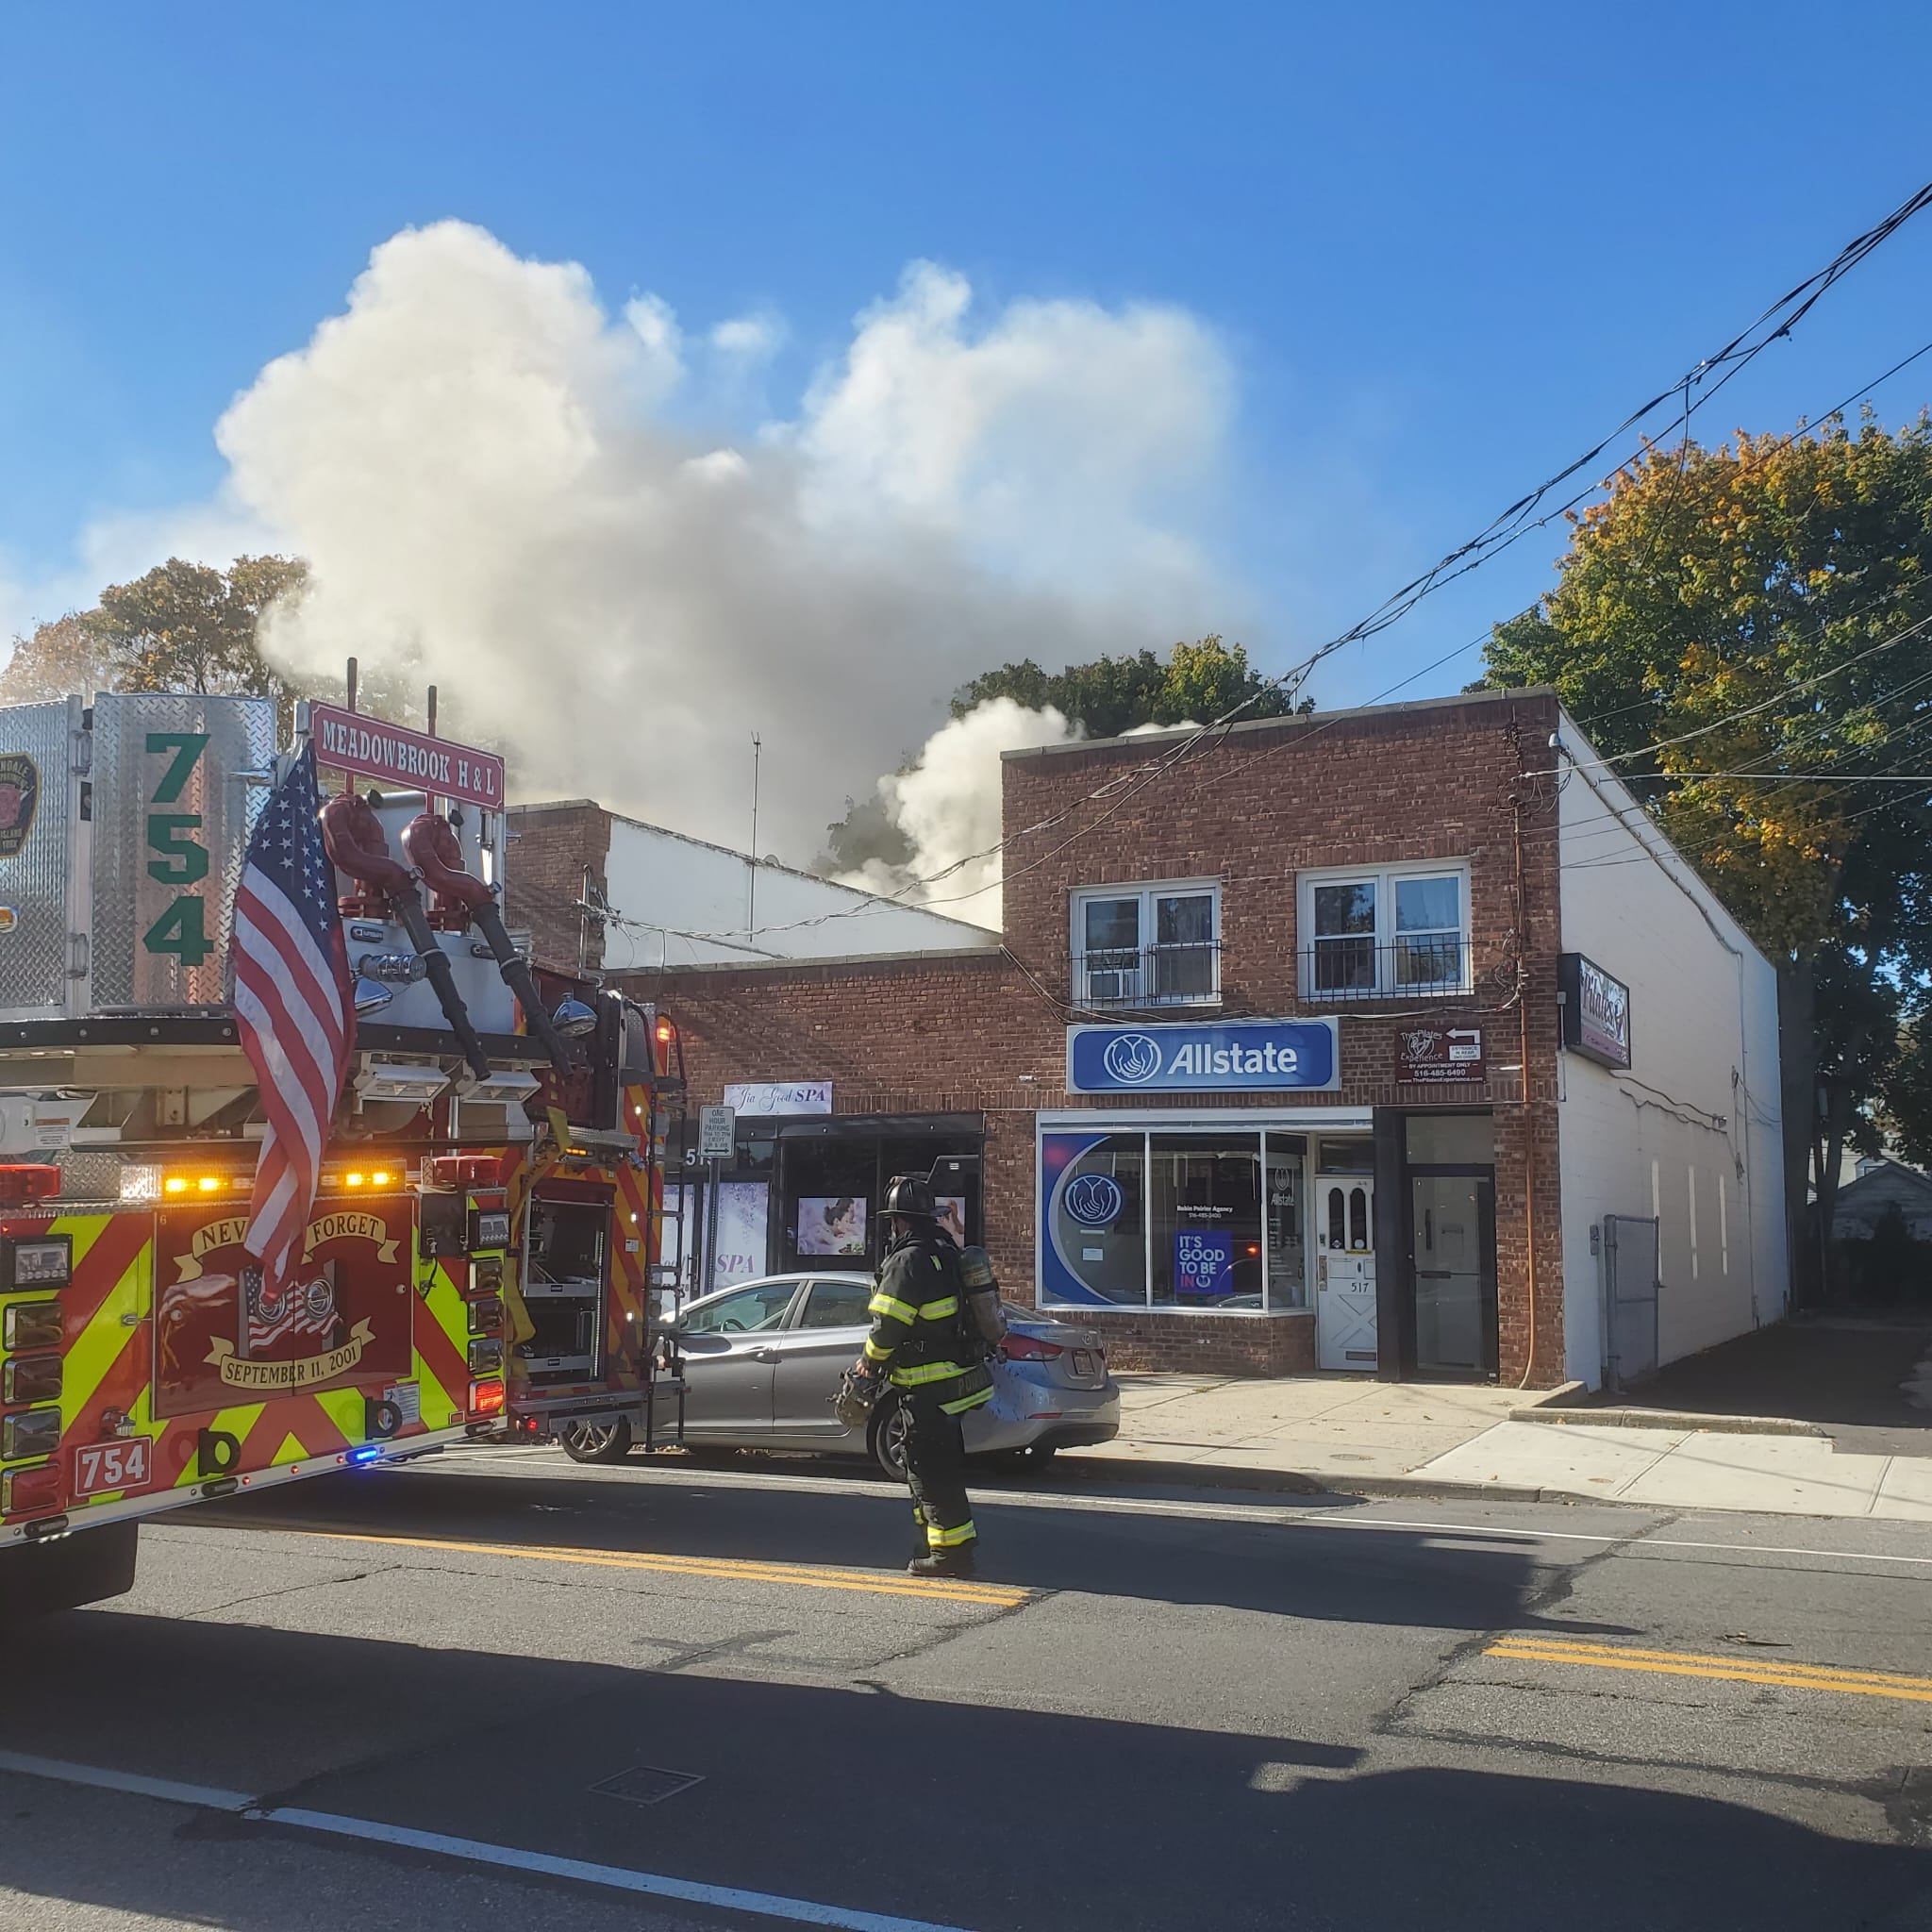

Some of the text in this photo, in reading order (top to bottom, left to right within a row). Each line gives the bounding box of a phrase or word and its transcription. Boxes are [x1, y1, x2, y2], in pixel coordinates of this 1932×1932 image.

[322, 719, 494, 796] MEADOWBROOK H & L
[1584, 972, 1614, 1029] Pilates
[1417, 1029, 1442, 1041] Pilates
[1167, 1041, 1298, 1074] Allstate
[1400, 1052, 1443, 1062] Experience
[758, 1086, 792, 1112] Good
[794, 1089, 825, 1103] SPA
[712, 1108, 724, 1117] ONE
[686, 1148, 712, 1166] 51
[1271, 1192, 1295, 1207] Allstate
[201, 1214, 379, 1250] NEV FORGET
[1179, 1235, 1202, 1248] IT'S
[1179, 1249, 1224, 1262] GOOD
[716, 1254, 755, 1274] SPA
[1179, 1261, 1216, 1274] TO BE
[1180, 1275, 1194, 1288] IN
[1351, 1282, 1369, 1292] 517
[225, 1362, 306, 1385] SEPTEMBER
[329, 1345, 357, 1372] 2001
[82, 1444, 144, 1489] 754
